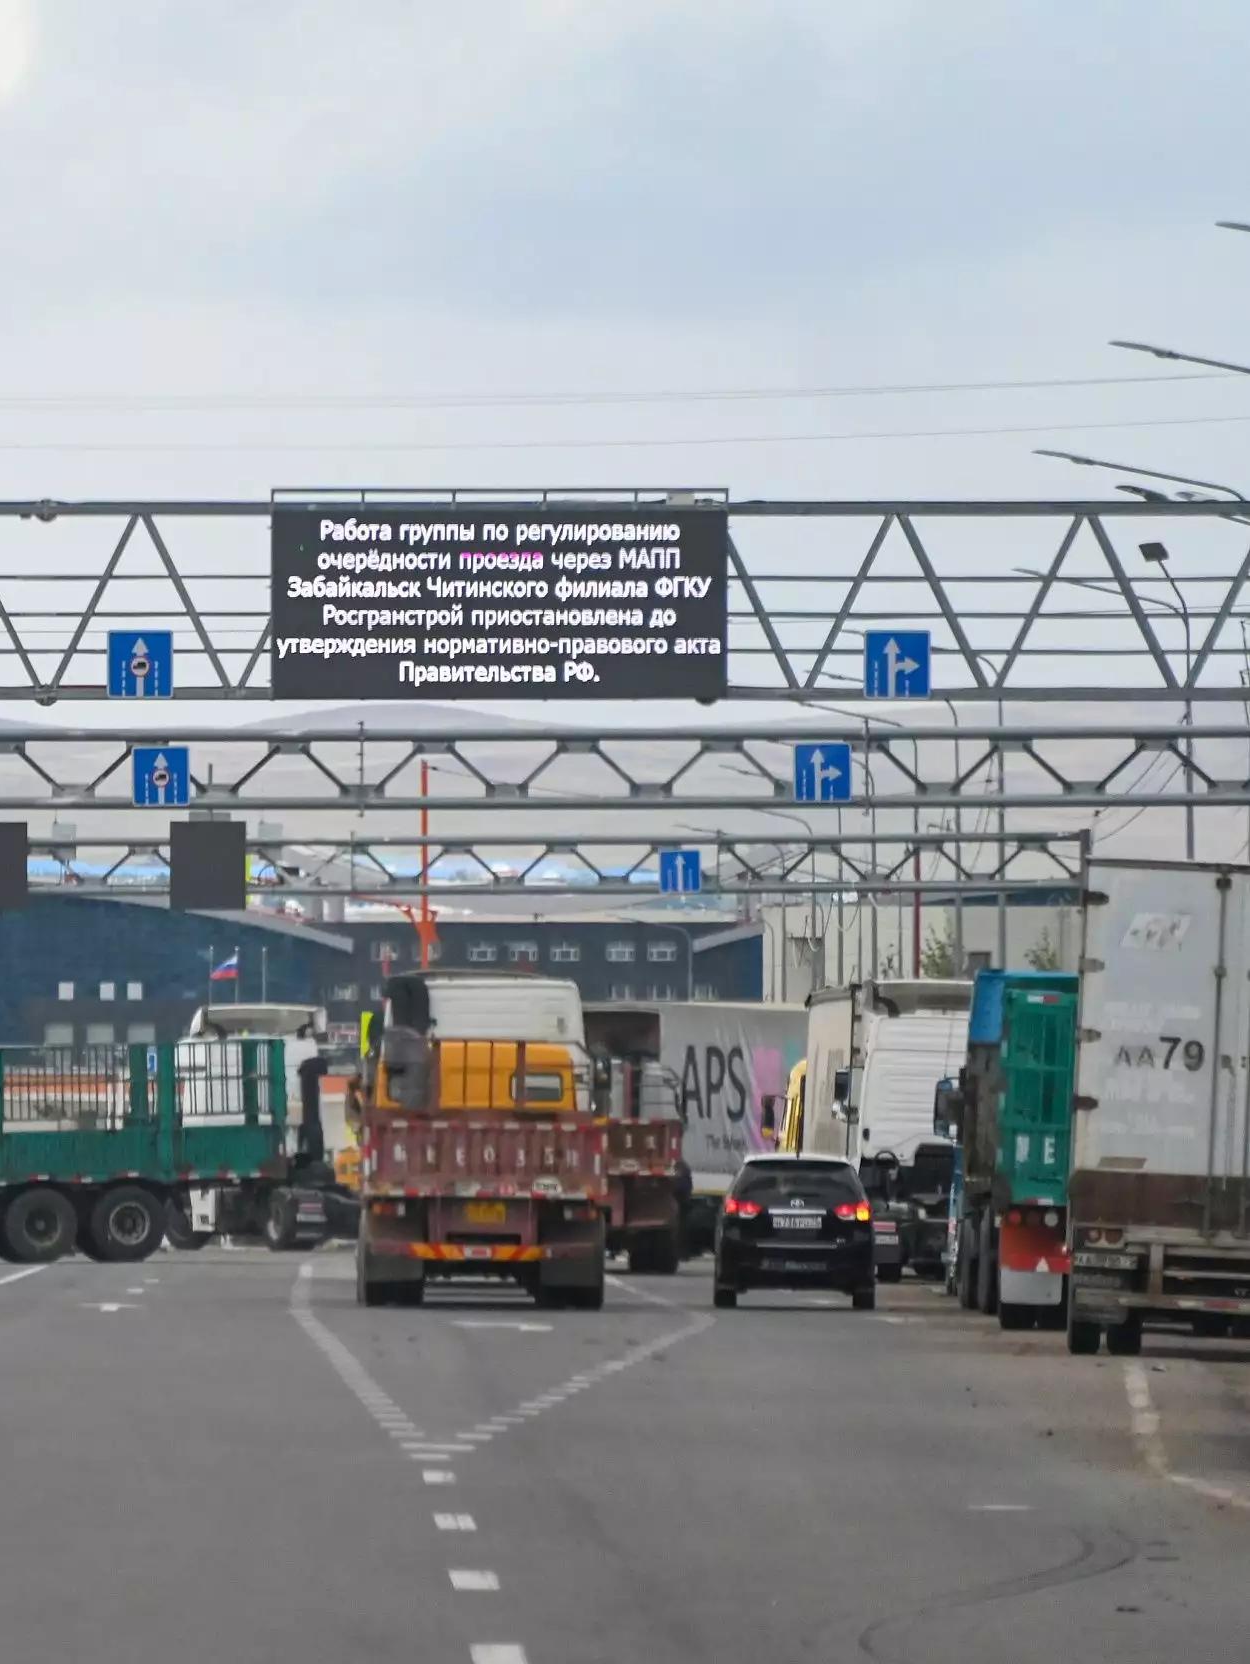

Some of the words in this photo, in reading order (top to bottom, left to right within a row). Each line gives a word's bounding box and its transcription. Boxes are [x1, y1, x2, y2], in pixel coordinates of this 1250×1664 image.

[320, 518, 392, 541] Работа
[399, 523, 475, 546] группы
[483, 523, 509, 541] по
[515, 523, 681, 546] регулированию
[317, 546, 451, 574] очерёдности
[459, 552, 543, 574] проезда
[551, 552, 612, 574] через
[619, 547, 680, 569] МАПП
[287, 574, 421, 598] Забайкальск
[427, 575, 548, 598] Читинского
[554, 575, 648, 602] филиала
[654, 575, 711, 598] ФГКУ
[323, 603, 463, 631] Росгранстрой
[471, 608, 643, 630] приостановлена
[648, 608, 676, 630] до
[277, 637, 416, 659] утверждения
[424, 637, 668, 659] нормативно-правового
[674, 637, 721, 655] акта
[399, 660, 556, 687] Правительства
[563, 660, 600, 682] РФ.
[681, 1045, 747, 1123] APS
